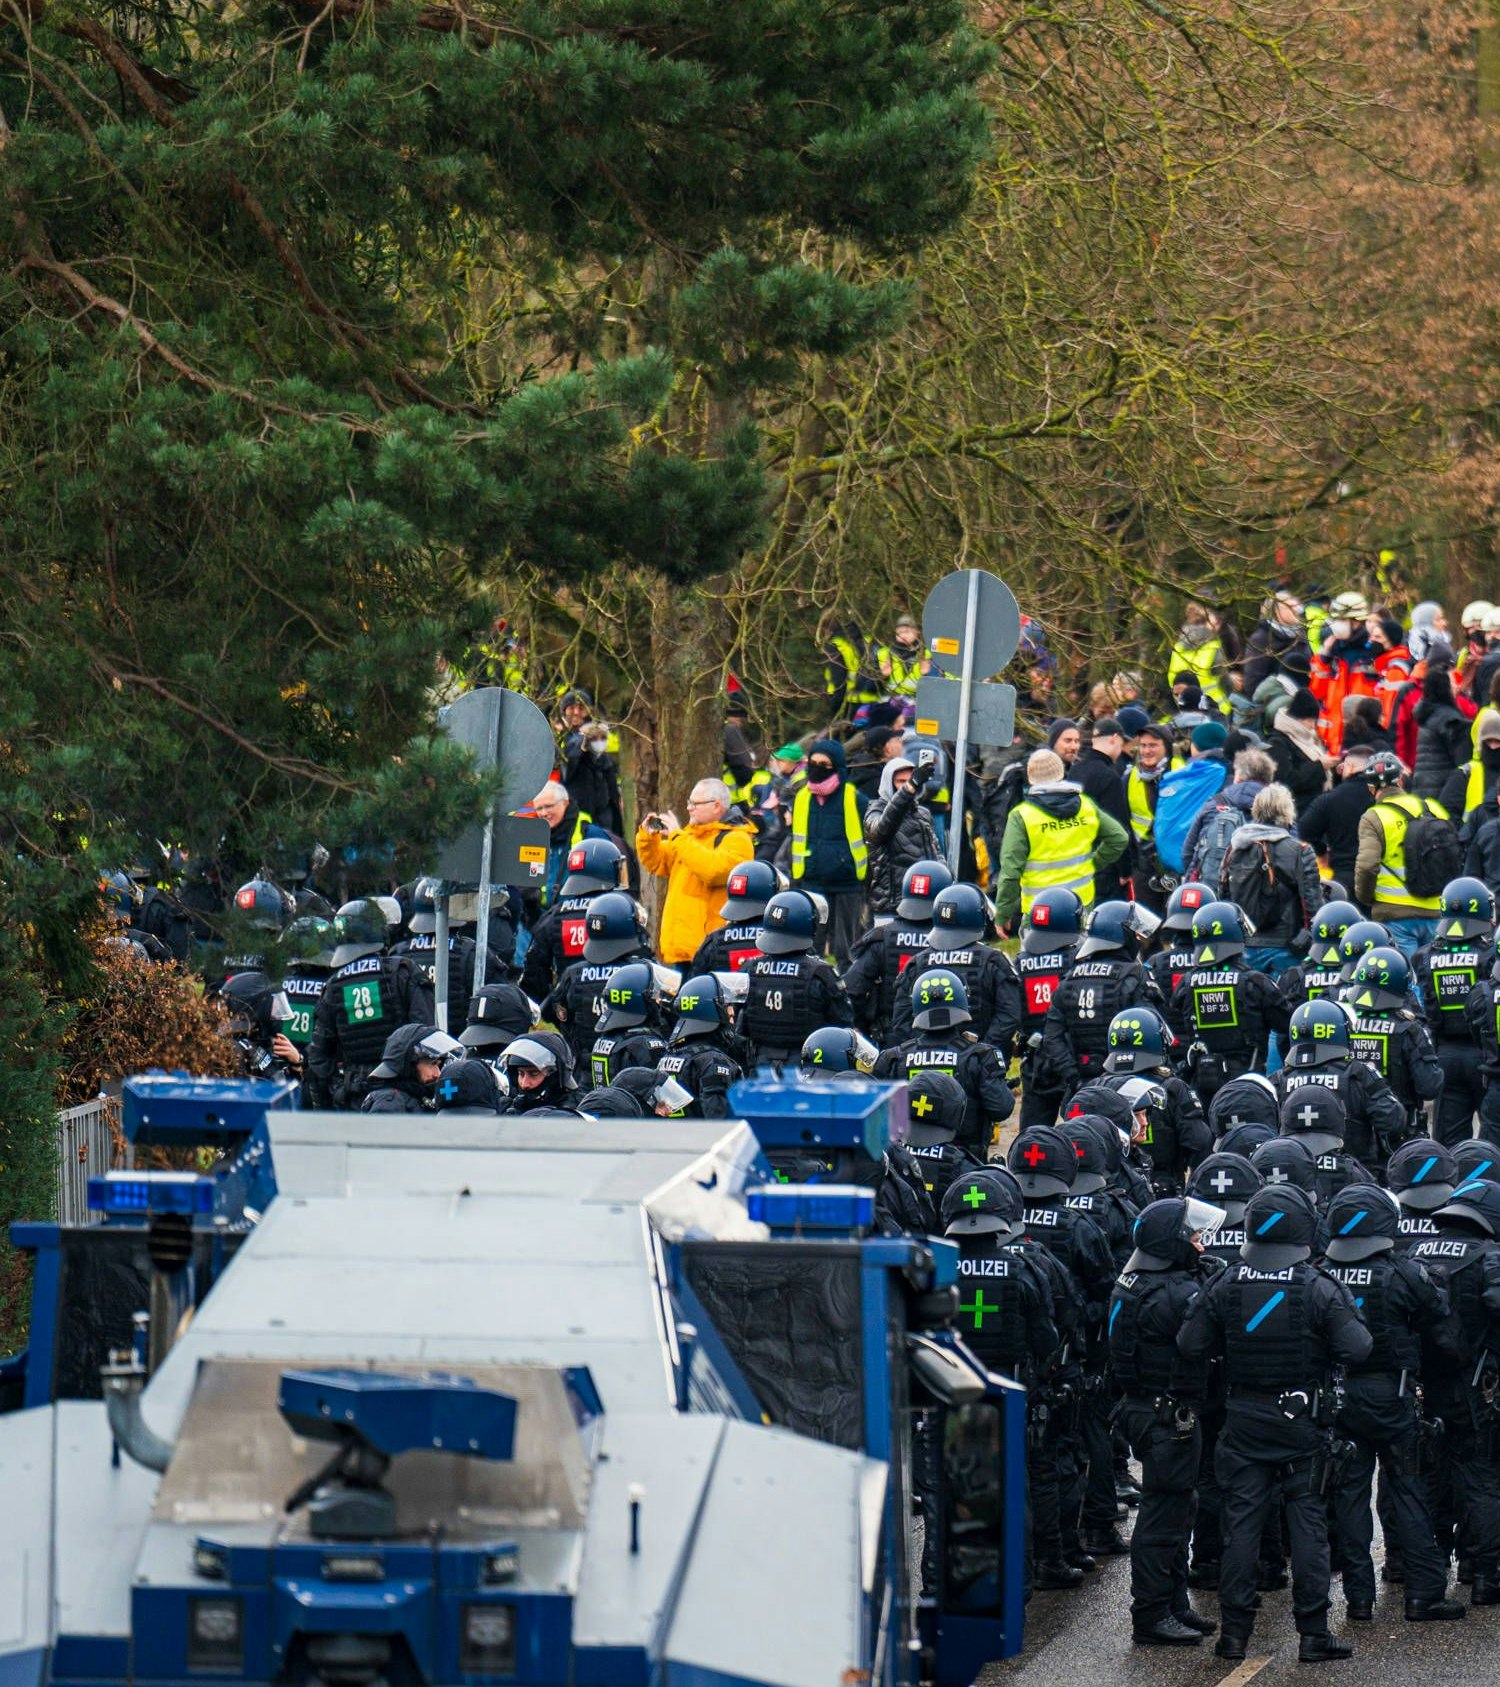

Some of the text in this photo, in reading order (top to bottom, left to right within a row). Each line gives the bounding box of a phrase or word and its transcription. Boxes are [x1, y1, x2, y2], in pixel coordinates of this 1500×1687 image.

[1041, 817, 1088, 834] PRESSE
[772, 907, 783, 919] 48
[940, 906, 951, 919] 48
[1440, 899, 1478, 913] 3 2
[591, 918, 601, 931] 48
[1192, 921, 1223, 938] 3 2
[1319, 924, 1348, 938] 3 2
[570, 927, 585, 945] 28
[724, 926, 764, 942] POLIZE
[1344, 941, 1352, 956] 3
[928, 951, 973, 966] POLIZEI
[1020, 954, 1063, 971] POLIZEI
[1430, 953, 1479, 968] POLIZEI
[337, 958, 381, 978] POLIZEI
[756, 961, 799, 976] POLIZEI
[1073, 964, 1112, 978] POLIZEI
[1190, 972, 1239, 986] POLIZEI
[1359, 970, 1389, 985] 3 2
[1442, 975, 1465, 985] NRW
[352, 987, 371, 1008] 28
[610, 989, 632, 1005] BF
[920, 987, 954, 1005] 3 2
[1034, 983, 1051, 1004] 28
[1440, 985, 1470, 996] 3 BF 23
[680, 996, 699, 1011] BF
[765, 990, 783, 1011] 48
[1078, 989, 1095, 1009] 48
[1202, 993, 1225, 1004] NRW
[1200, 1004, 1229, 1014] 3 BF 23
[290, 1011, 310, 1033] 28
[1110, 1030, 1143, 1047] 3 2
[1291, 1023, 1336, 1040] 3 BF
[1354, 1039, 1378, 1050] NRW
[813, 1048, 823, 1063] 2
[906, 1051, 958, 1067] POLIZEI
[1357, 1051, 1369, 1060] BF
[1370, 1051, 1381, 1060] 23
[1415, 1241, 1467, 1257] POLIZEI
